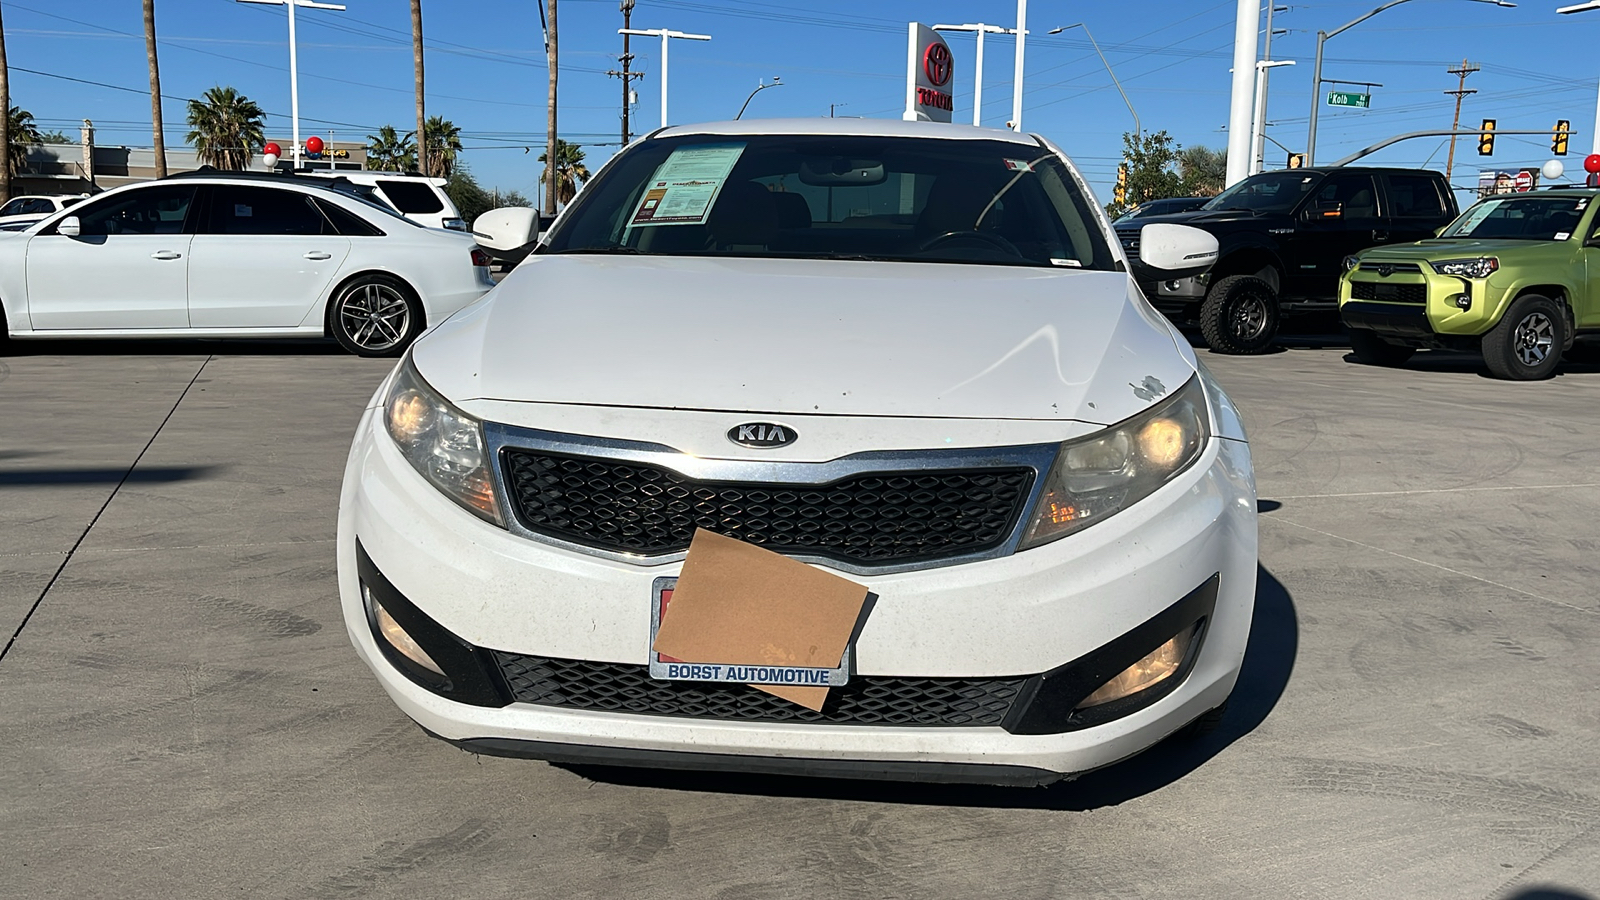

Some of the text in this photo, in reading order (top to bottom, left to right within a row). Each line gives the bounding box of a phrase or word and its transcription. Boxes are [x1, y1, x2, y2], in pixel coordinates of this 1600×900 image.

[916, 87, 954, 111] TOYOTA
[1332, 94, 1348, 105] Kolb
[738, 425, 786, 442] KIA
[668, 664, 830, 684] BORST AUTOMOTIVE
